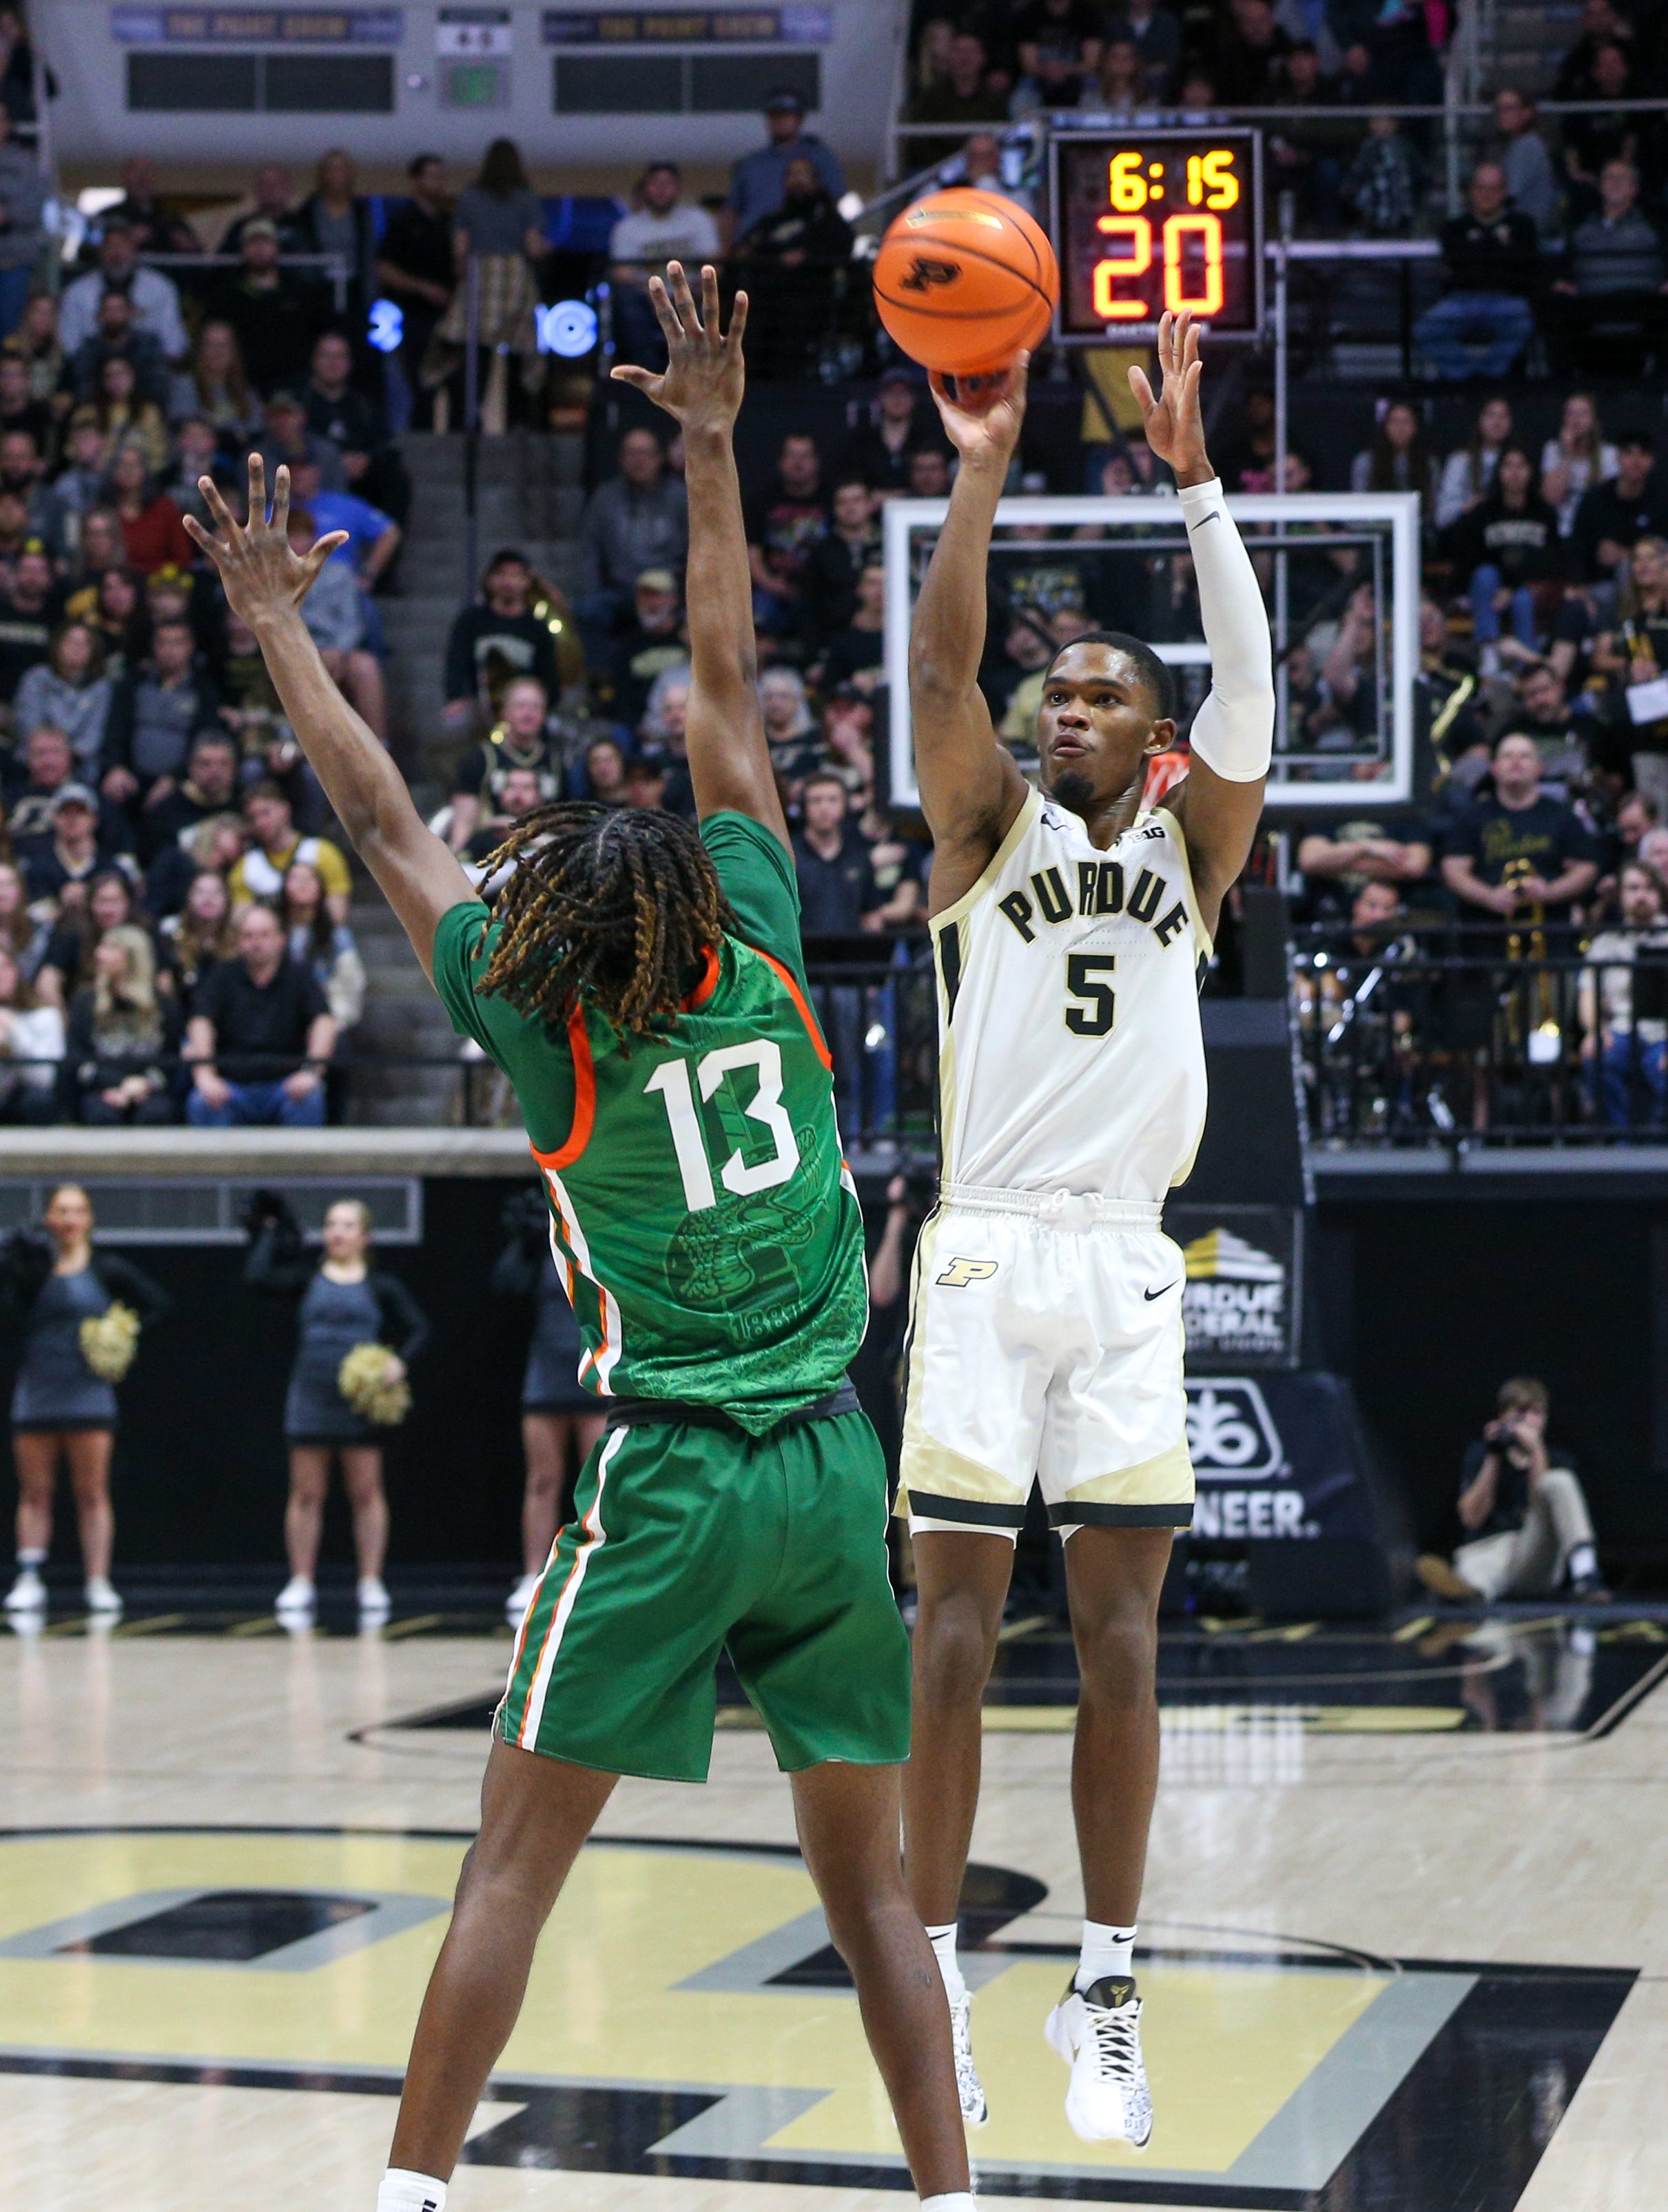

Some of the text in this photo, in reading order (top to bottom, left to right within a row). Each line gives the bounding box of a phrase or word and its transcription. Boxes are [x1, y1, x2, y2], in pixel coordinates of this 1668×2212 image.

[1109, 150, 1239, 212] 6:15
[1093, 214, 1224, 318] 20
[998, 859, 1191, 948] PURDUE
[1064, 953, 1116, 1039] 5
[642, 1038, 801, 1213] 13
